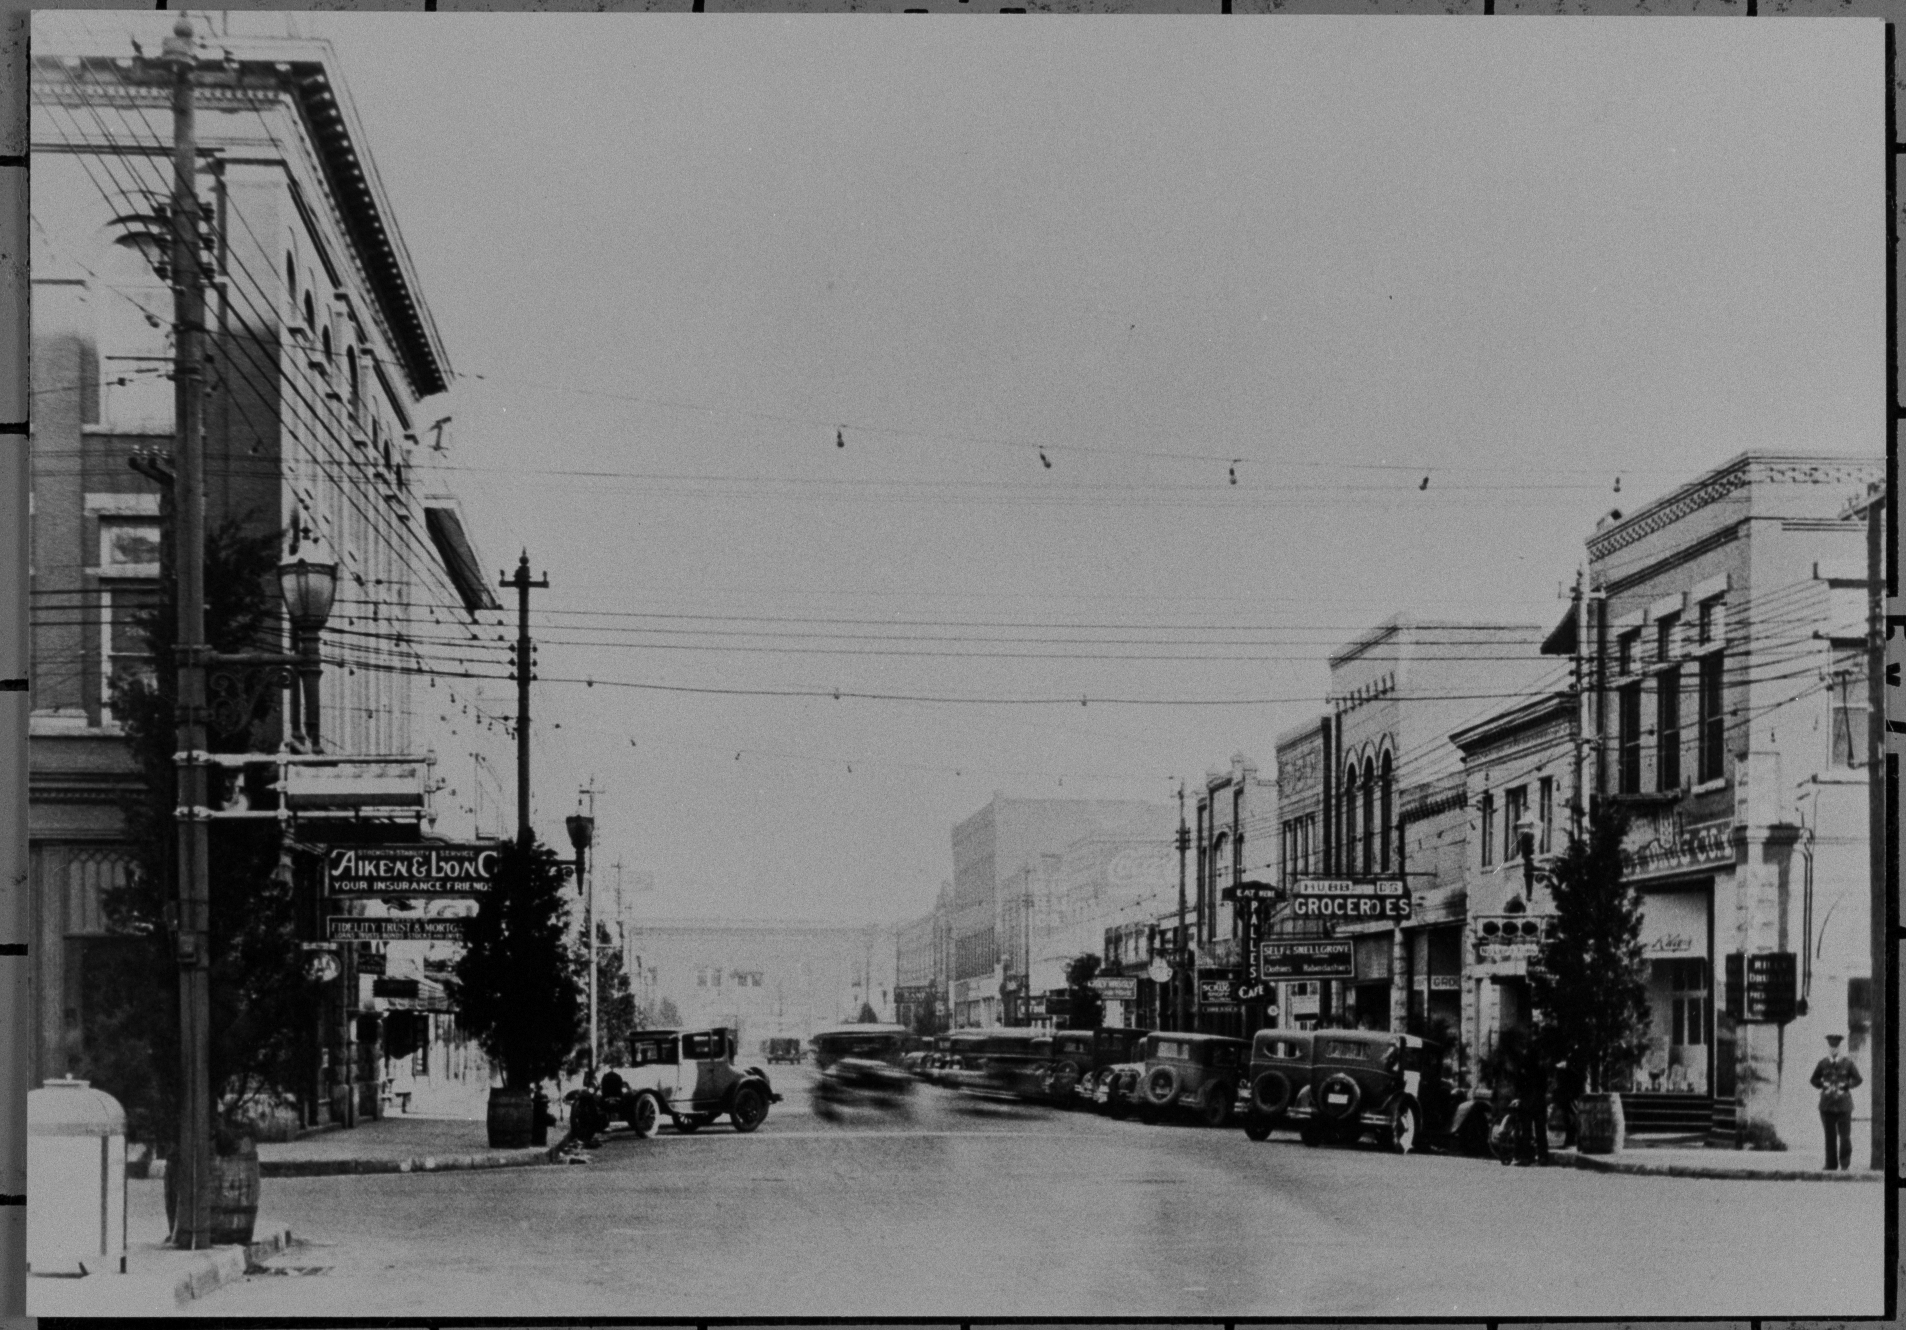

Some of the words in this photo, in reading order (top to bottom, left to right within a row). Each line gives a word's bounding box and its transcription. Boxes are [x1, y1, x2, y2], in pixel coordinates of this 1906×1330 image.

[330, 849, 409, 877] AIKEN
[411, 856, 428, 878] &
[333, 881, 368, 891] YOUR
[373, 881, 443, 891] INSURANCE
[1236, 888, 1256, 898] EAT
[331, 922, 377, 932] FIDELITY
[380, 922, 411, 932] TRUST
[413, 923, 421, 932] &
[424, 922, 464, 932] MORTG
